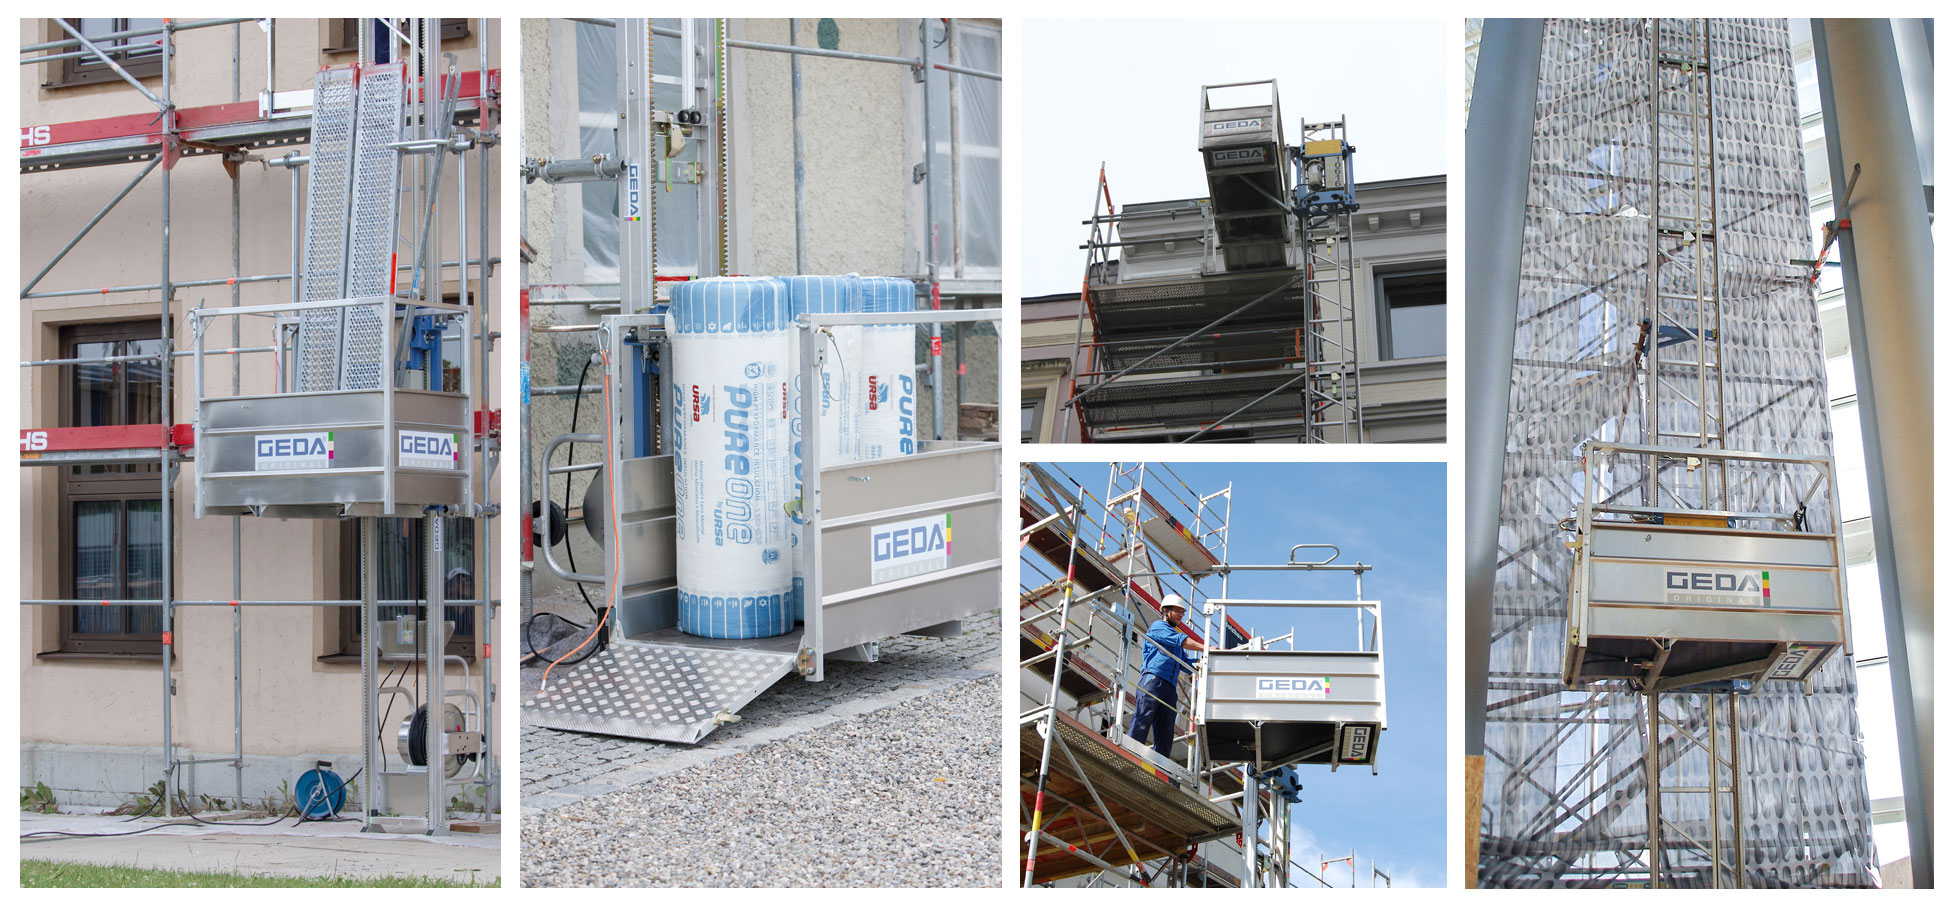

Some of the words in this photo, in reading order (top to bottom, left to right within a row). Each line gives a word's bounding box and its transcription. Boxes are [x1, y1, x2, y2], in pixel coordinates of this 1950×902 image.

[1213, 119, 1260, 130] GEDA
[20, 126, 50, 146] HS
[1215, 149, 1262, 161] GEDA
[630, 165, 638, 216] GEDA
[257, 437, 327, 457] GEDA
[400, 435, 452, 456] GEDA
[753, 458, 761, 501] INSULATION
[874, 523, 945, 562] GEDA
[880, 560, 941, 580] ORIGINAL
[1666, 571, 1760, 592] GEDA
[1673, 595, 1755, 605] ORIGINAL
[1772, 649, 1809, 677] GEDA
[1259, 679, 1323, 691] GEDA
[1351, 728, 1367, 757] GEDA
